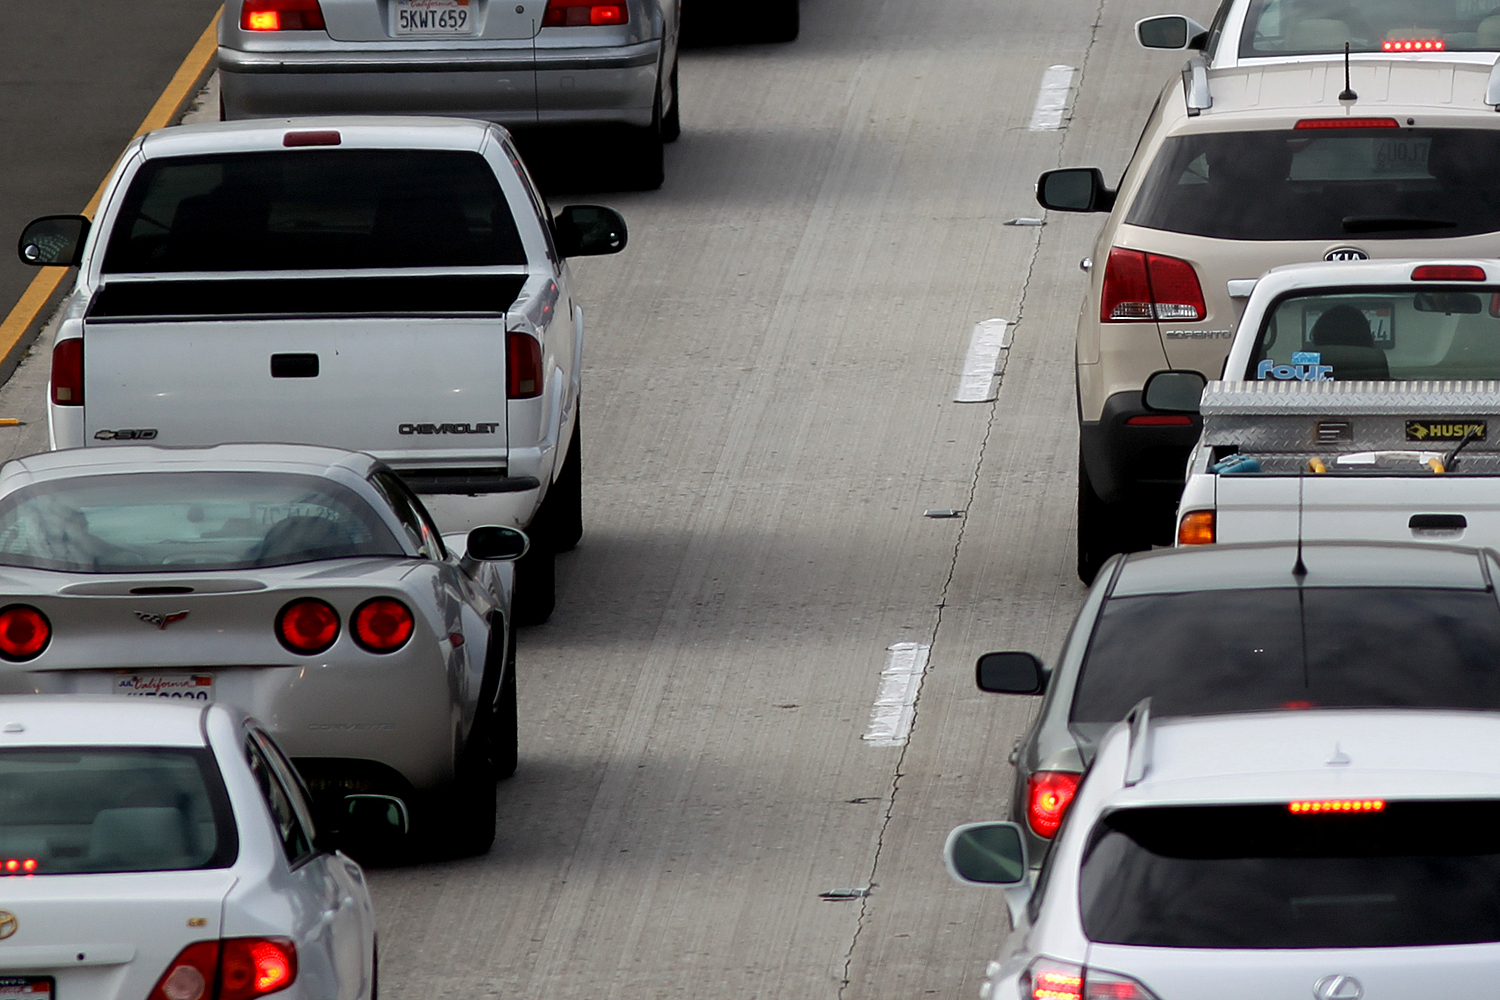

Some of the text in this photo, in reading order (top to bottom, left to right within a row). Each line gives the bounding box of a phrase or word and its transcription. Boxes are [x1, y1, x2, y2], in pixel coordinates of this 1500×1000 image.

[400, 10, 467, 28] 5KWT659
[1332, 253, 1361, 261] KIA
[1165, 329, 1232, 340] SORENTO
[1257, 359, 1333, 380] four
[114, 429, 158, 440] S10
[399, 423, 499, 434] CHEVROLET
[1429, 424, 1485, 437] HUSKY
[134, 678, 191, 692] California
